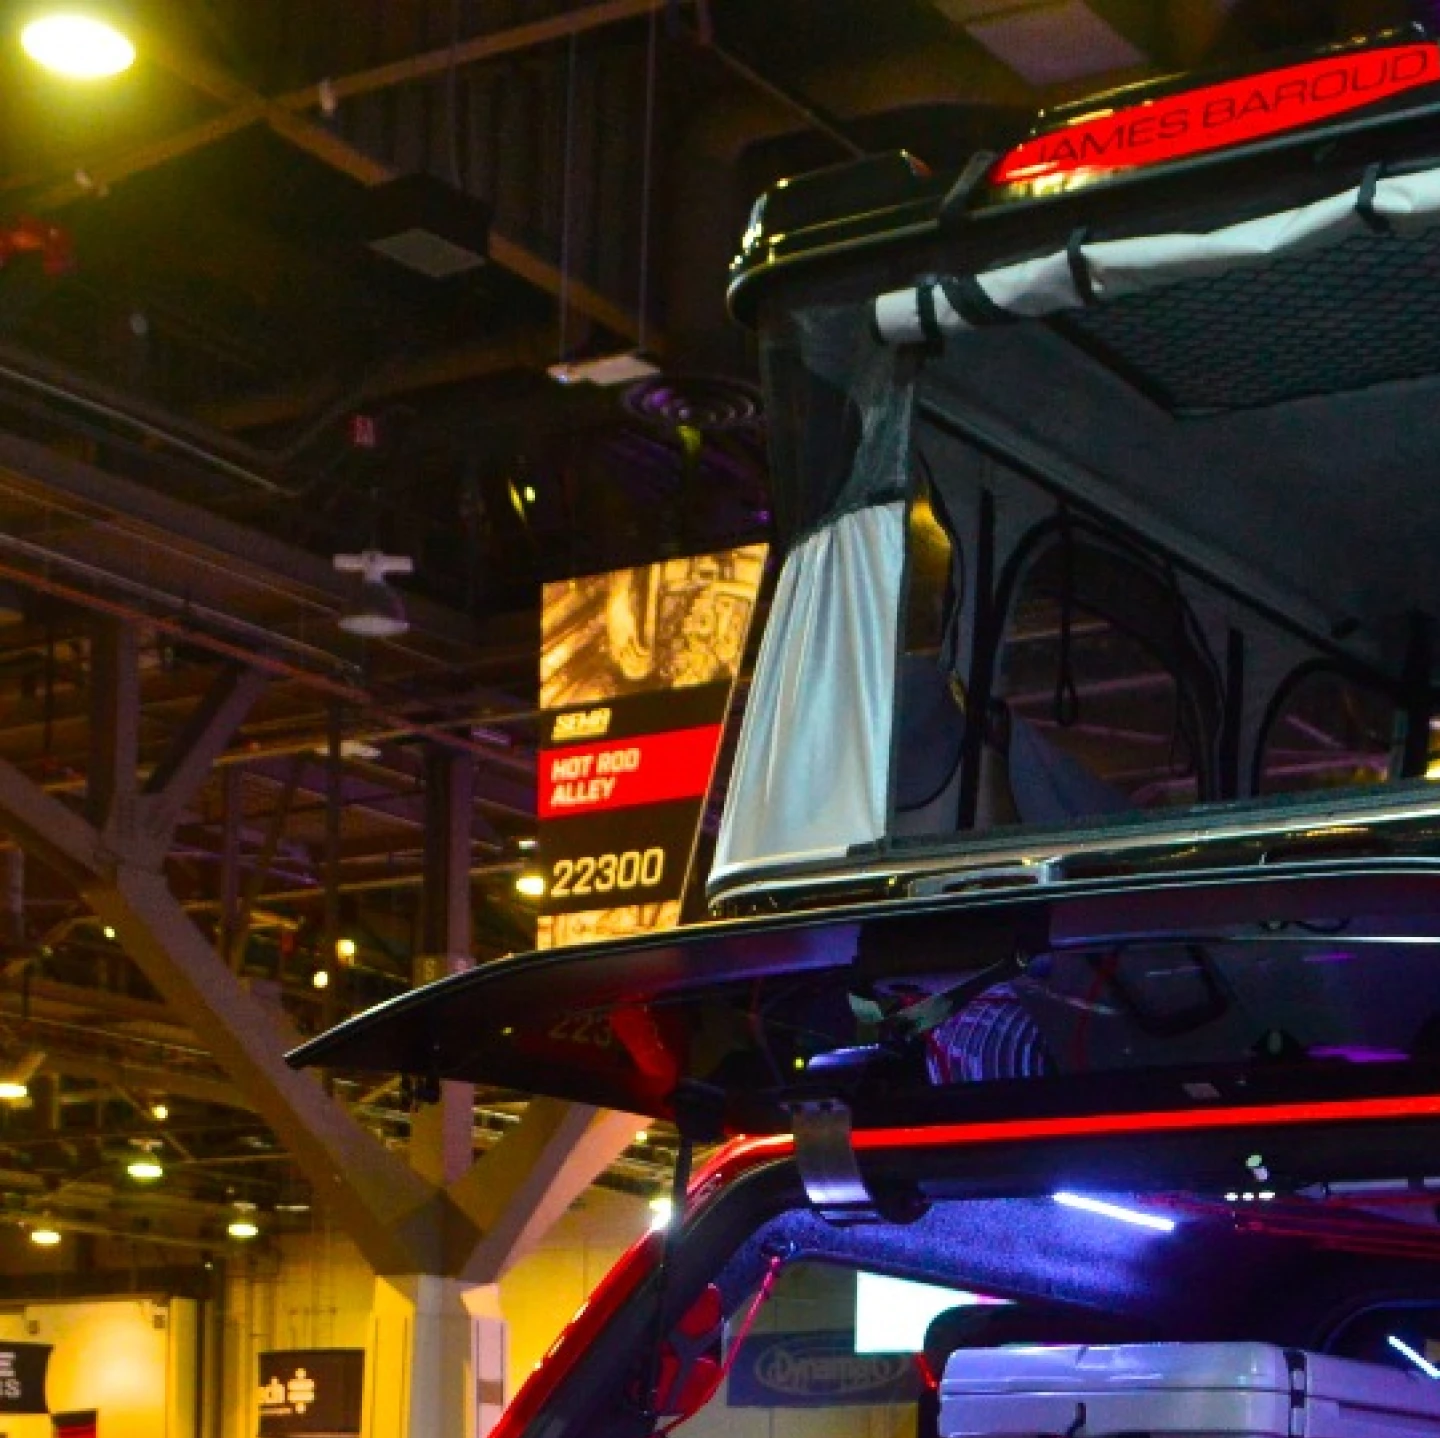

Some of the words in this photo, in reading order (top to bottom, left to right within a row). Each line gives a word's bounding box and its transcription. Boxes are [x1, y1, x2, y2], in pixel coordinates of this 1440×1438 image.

[1203, 49, 1430, 129] BAROUD
[550, 755, 594, 781] HOT
[596, 747, 641, 773] ROD
[550, 776, 616, 808] ALLEY
[550, 847, 666, 897] 22300
